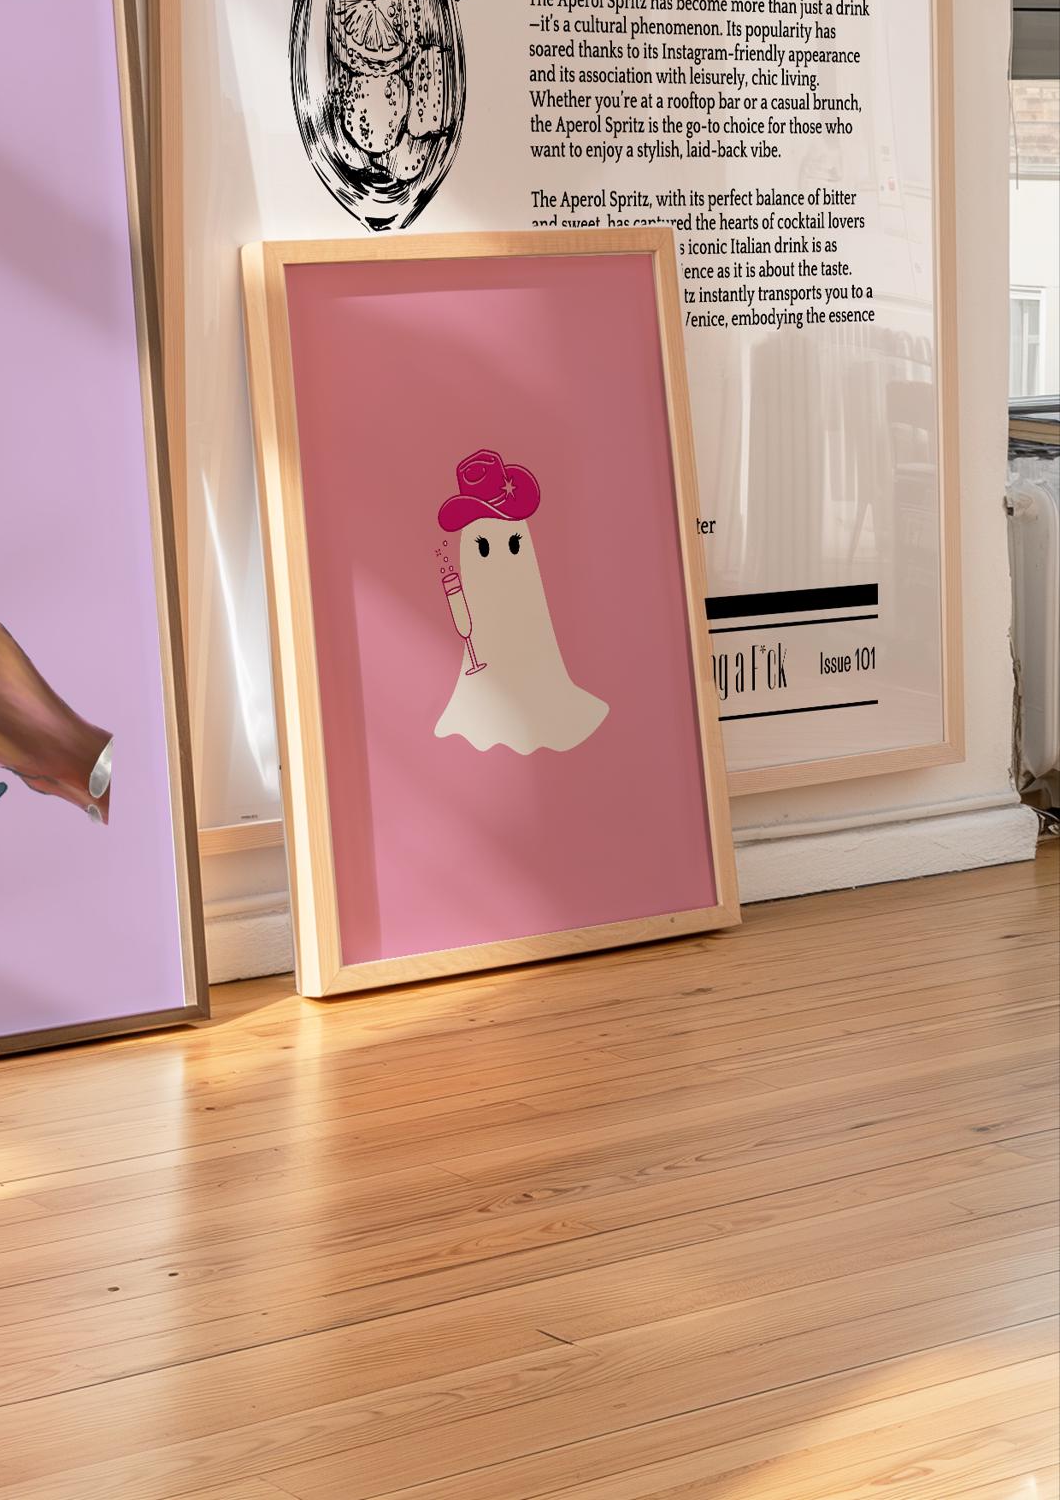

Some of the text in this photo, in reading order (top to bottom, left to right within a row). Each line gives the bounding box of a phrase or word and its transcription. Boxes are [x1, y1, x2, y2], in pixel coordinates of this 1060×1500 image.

[730, 0, 765, 13] more
[825, 2, 833, 16] a
[562, 19, 571, 33] a
[573, 14, 628, 34] cultural
[630, 15, 723, 40] phenomenon.
[726, 19, 742, 37] Its
[745, 19, 813, 44] popularity
[815, 20, 837, 39] has
[529, 38, 861, 68] soared thanks to its Instagram-friendly appearance
[529, 63, 820, 92] and its association with leisurely, chic living.
[528, 88, 862, 115] Whether you're at a rooftop bar or a casual brunch,
[530, 113, 853, 139] the Aperol Spritz is the go-to choice for those who
[529, 139, 782, 164] want to enjoy a stylish, laid-back vibe.
[530, 187, 857, 214] The Aperol Spritz, with its perfect balance of bitter
[695, 212, 717, 231] the
[718, 212, 759, 231] hearts
[761, 211, 776, 230] of
[777, 211, 825, 230] cocktail
[827, 211, 865, 229] lovers
[687, 238, 728, 255] iconic
[730, 236, 772, 255] Italian
[774, 235, 810, 254] drink
[811, 236, 822, 253] is
[824, 240, 838, 253] as
[716, 266, 731, 279] as
[733, 261, 743, 278] it
[745, 260, 756, 278] is
[758, 259, 795, 278] about
[797, 259, 818, 277] the
[820, 260, 853, 277] taste.
[698, 284, 756, 308] instantly
[757, 285, 822, 306] transports
[824, 287, 849, 305] you
[851, 284, 864, 299] to
[865, 286, 874, 299] a
[731, 307, 804, 330] embodying
[806, 306, 826, 324] the
[828, 310, 875, 323] essence
[735, 651, 745, 694] a
[819, 646, 876, 675] Issue 101
